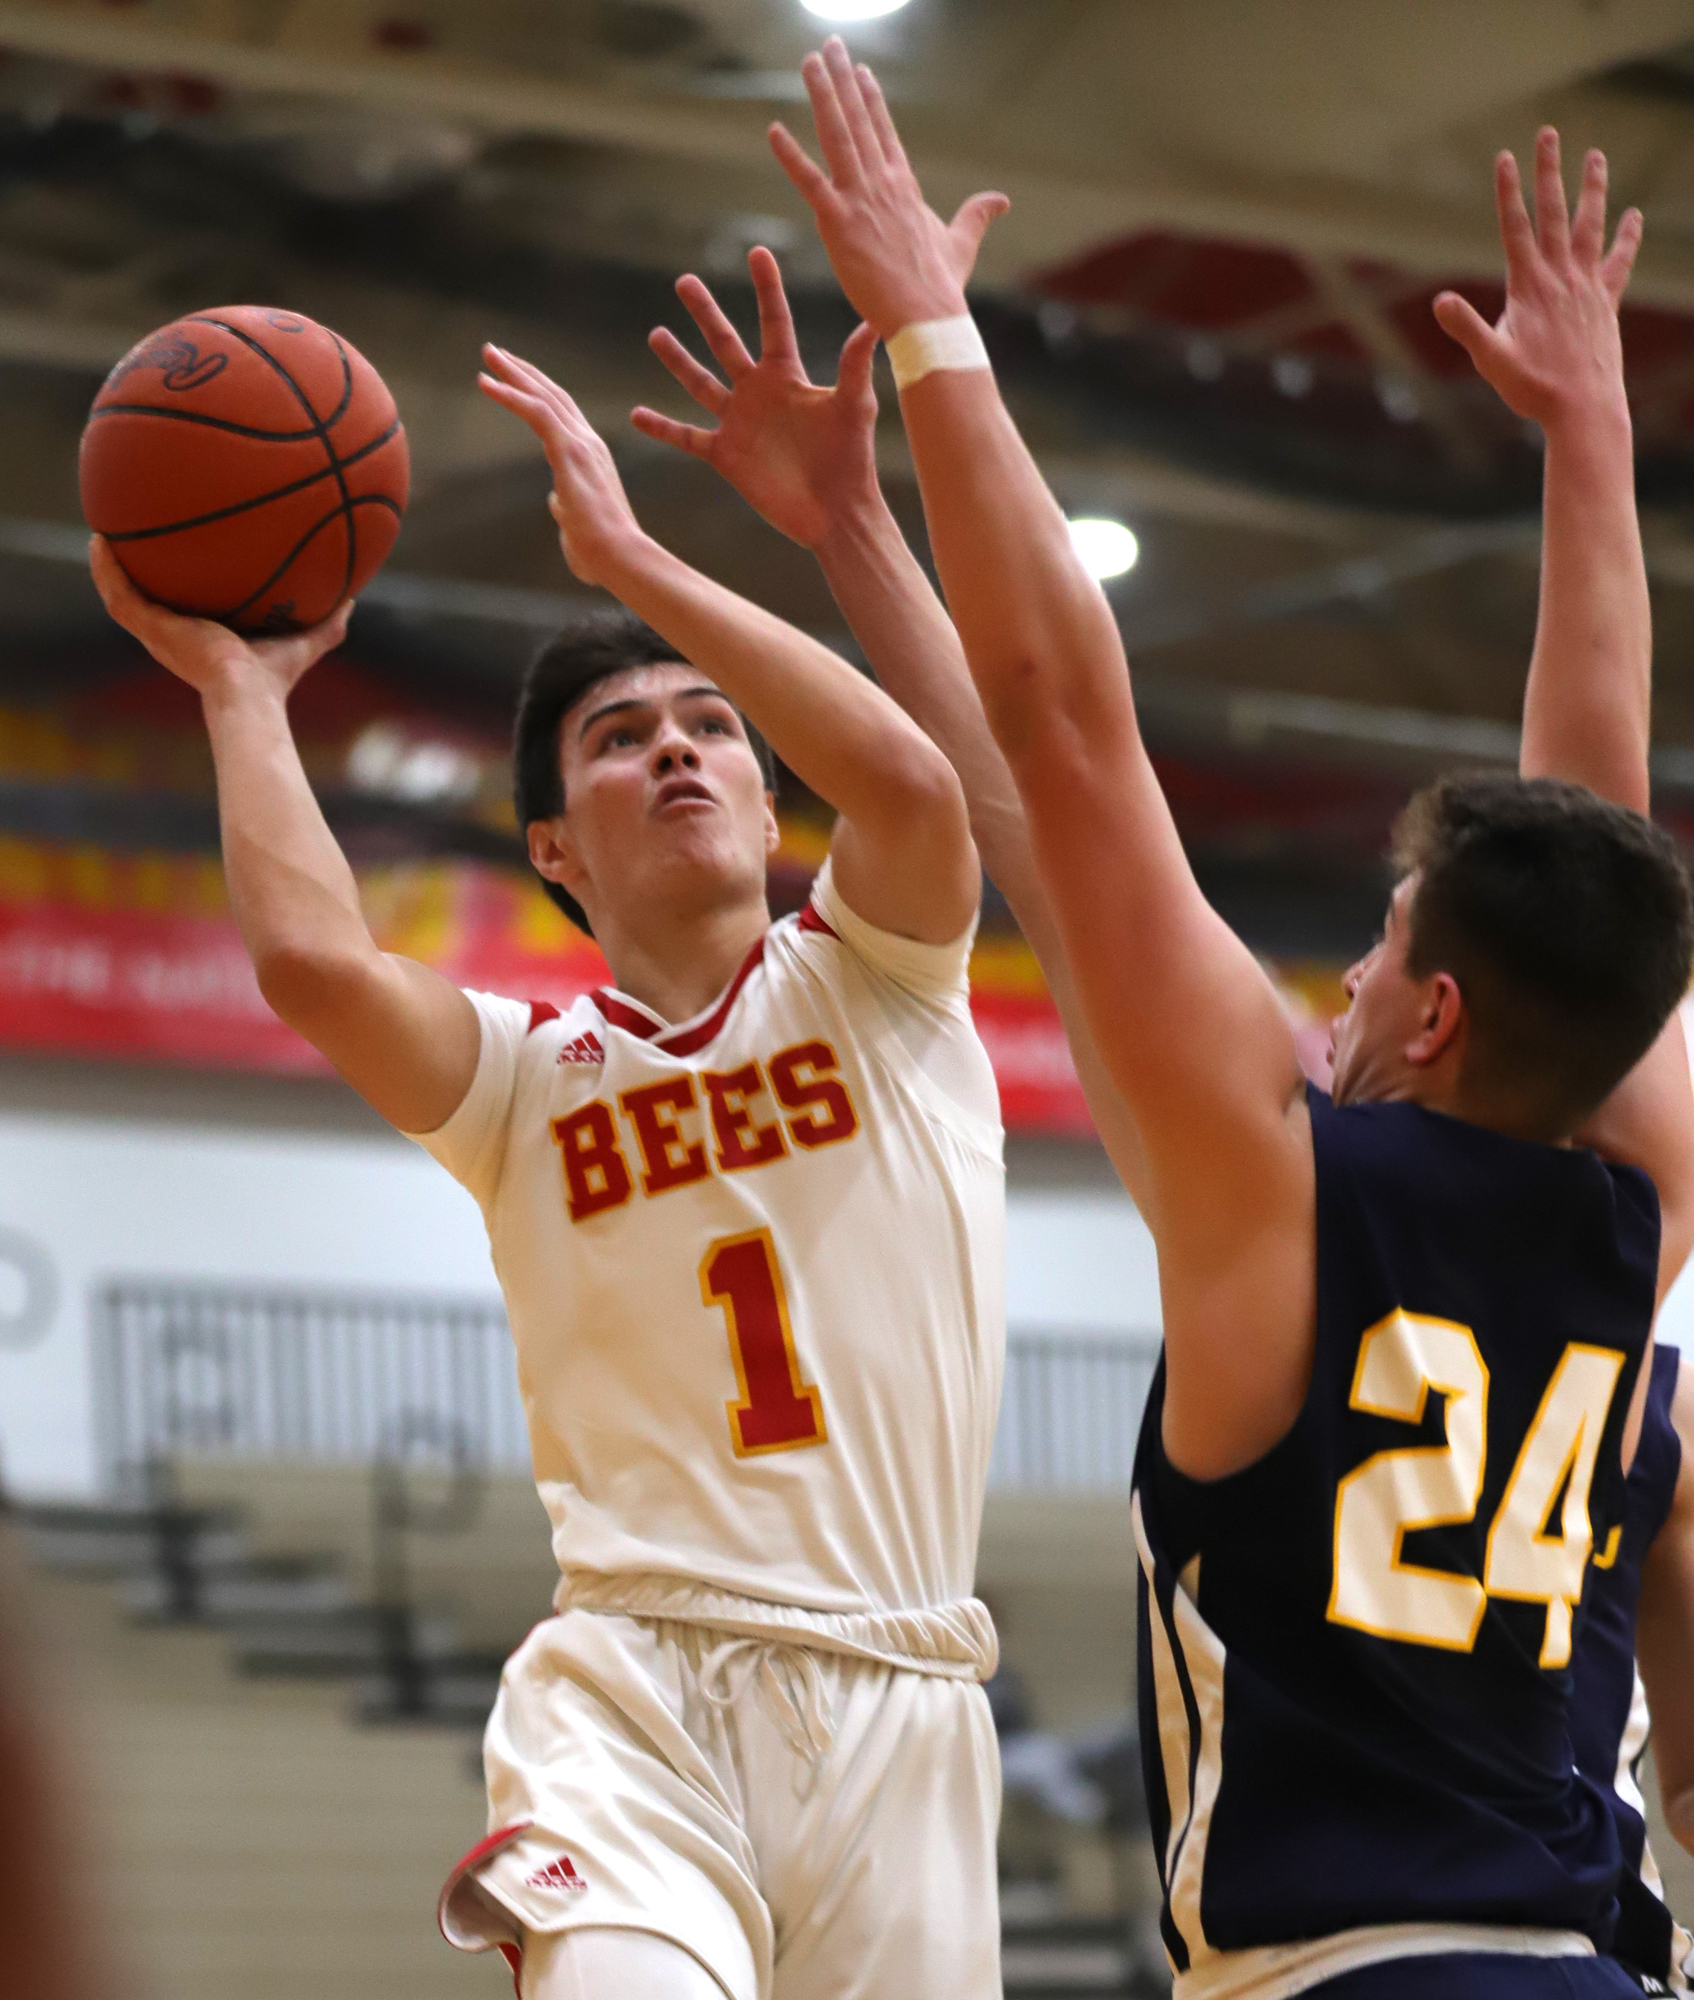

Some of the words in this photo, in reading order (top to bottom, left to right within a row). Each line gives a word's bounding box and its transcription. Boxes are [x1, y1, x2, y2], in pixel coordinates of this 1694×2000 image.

[549, 1038, 860, 1223] BEES
[697, 1226, 828, 1458] 1
[1325, 1305, 1627, 1669] 24
